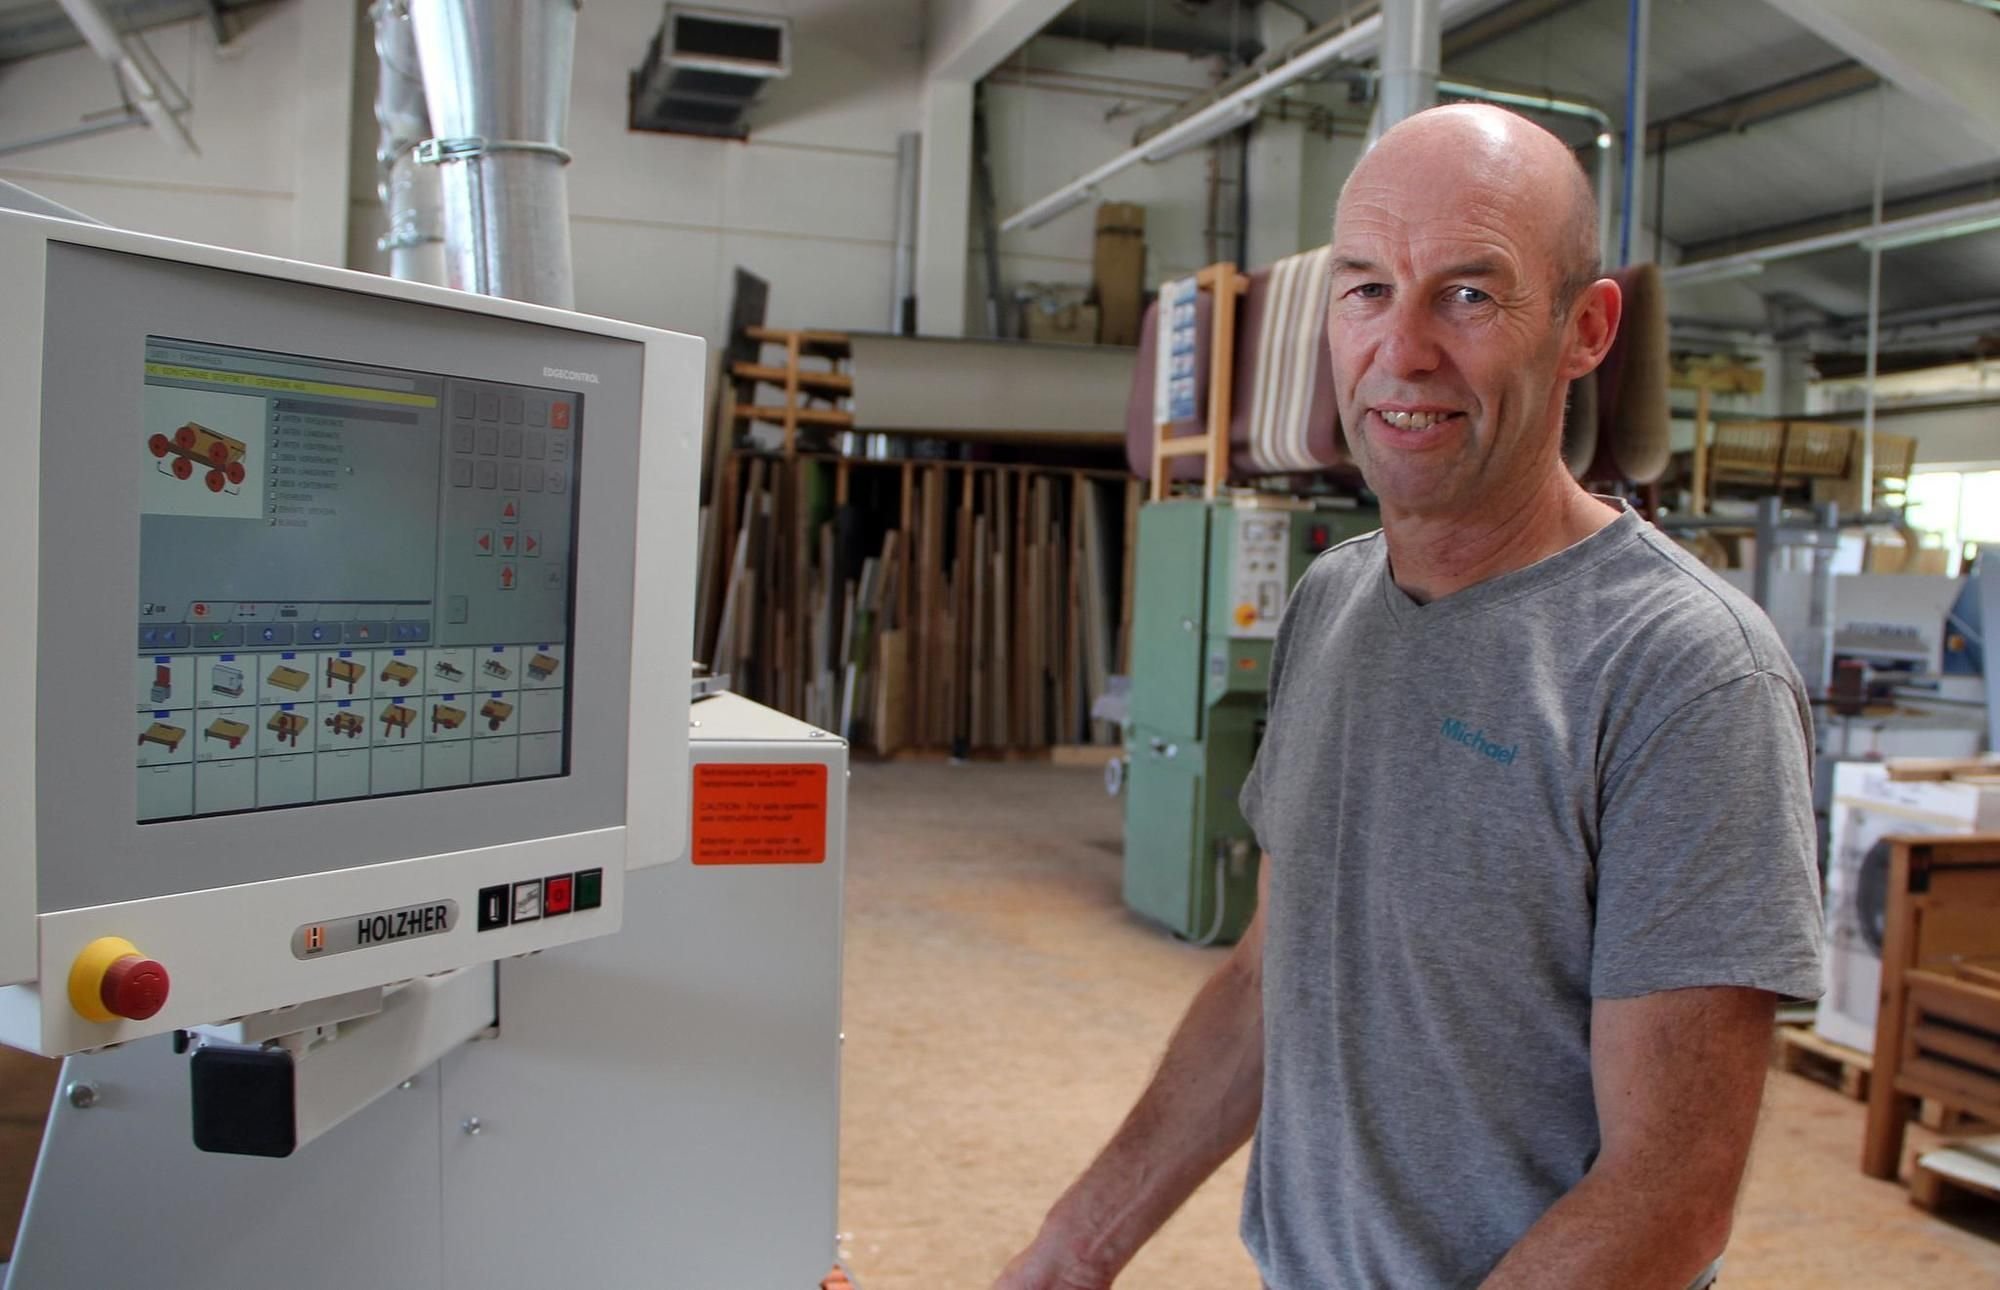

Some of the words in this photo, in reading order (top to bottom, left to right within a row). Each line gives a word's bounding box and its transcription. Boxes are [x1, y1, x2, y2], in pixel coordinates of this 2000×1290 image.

[543, 366, 601, 385] EDGECONTROL
[1440, 716, 1519, 767] Michael
[358, 905, 448, 944] HOLZHER
